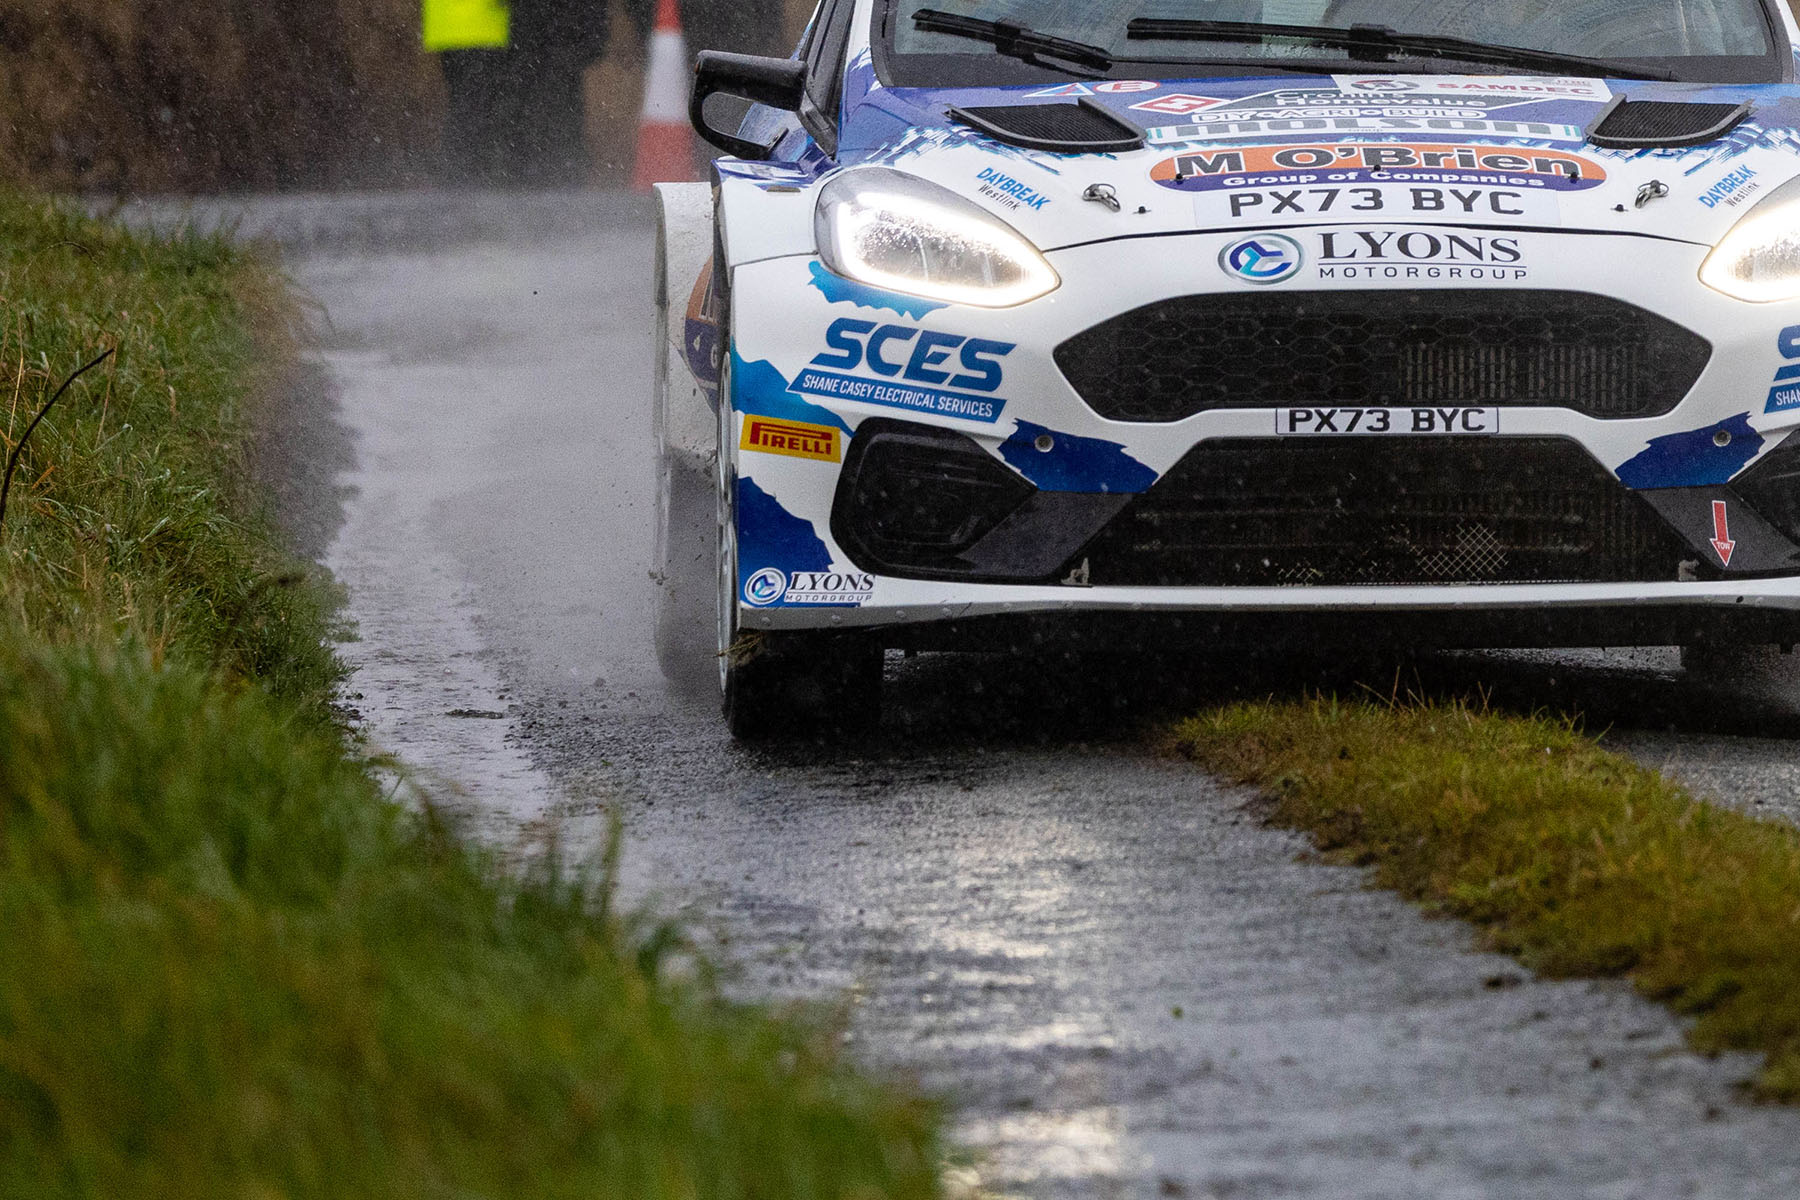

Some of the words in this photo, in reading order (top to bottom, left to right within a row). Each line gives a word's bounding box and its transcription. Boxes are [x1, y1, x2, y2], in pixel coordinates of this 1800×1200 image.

[1274, 91, 1407, 99] Cronins
[1437, 83, 1594, 95] SAMDEC
[1195, 112, 1252, 122] DIY
[1277, 108, 1356, 118] AGRI
[1386, 108, 1483, 118] BUILD
[1276, 98, 1487, 107] Homevalue
[1177, 153, 1243, 176] M
[1274, 147, 1581, 177] O'Brien
[976, 167, 1051, 211] DAYBREAK
[1223, 174, 1317, 186] Group
[1328, 171, 1359, 182] of
[1370, 171, 1545, 186] Companies
[1698, 164, 1758, 209] DAYBREAK
[978, 184, 1020, 211] Westlink
[1229, 188, 1384, 217] PX73
[1409, 188, 1524, 215] BYC
[1723, 182, 1760, 208] Westlink
[1317, 231, 1522, 263] LYONS
[1320, 266, 1527, 280] MOTORGROUP
[809, 317, 1018, 393] SCES
[802, 374, 841, 393] SHANE
[839, 379, 876, 398] CASEY
[874, 385, 936, 409] ELECTRICAL
[937, 395, 994, 418] SERVICES
[1288, 408, 1391, 432] PX73
[1410, 408, 1486, 432] BYC
[749, 421, 833, 456] PIRELLI
[1716, 542, 1730, 551] TOW
[790, 573, 876, 591] LYONS
[786, 594, 873, 602] MOTORGROUP
